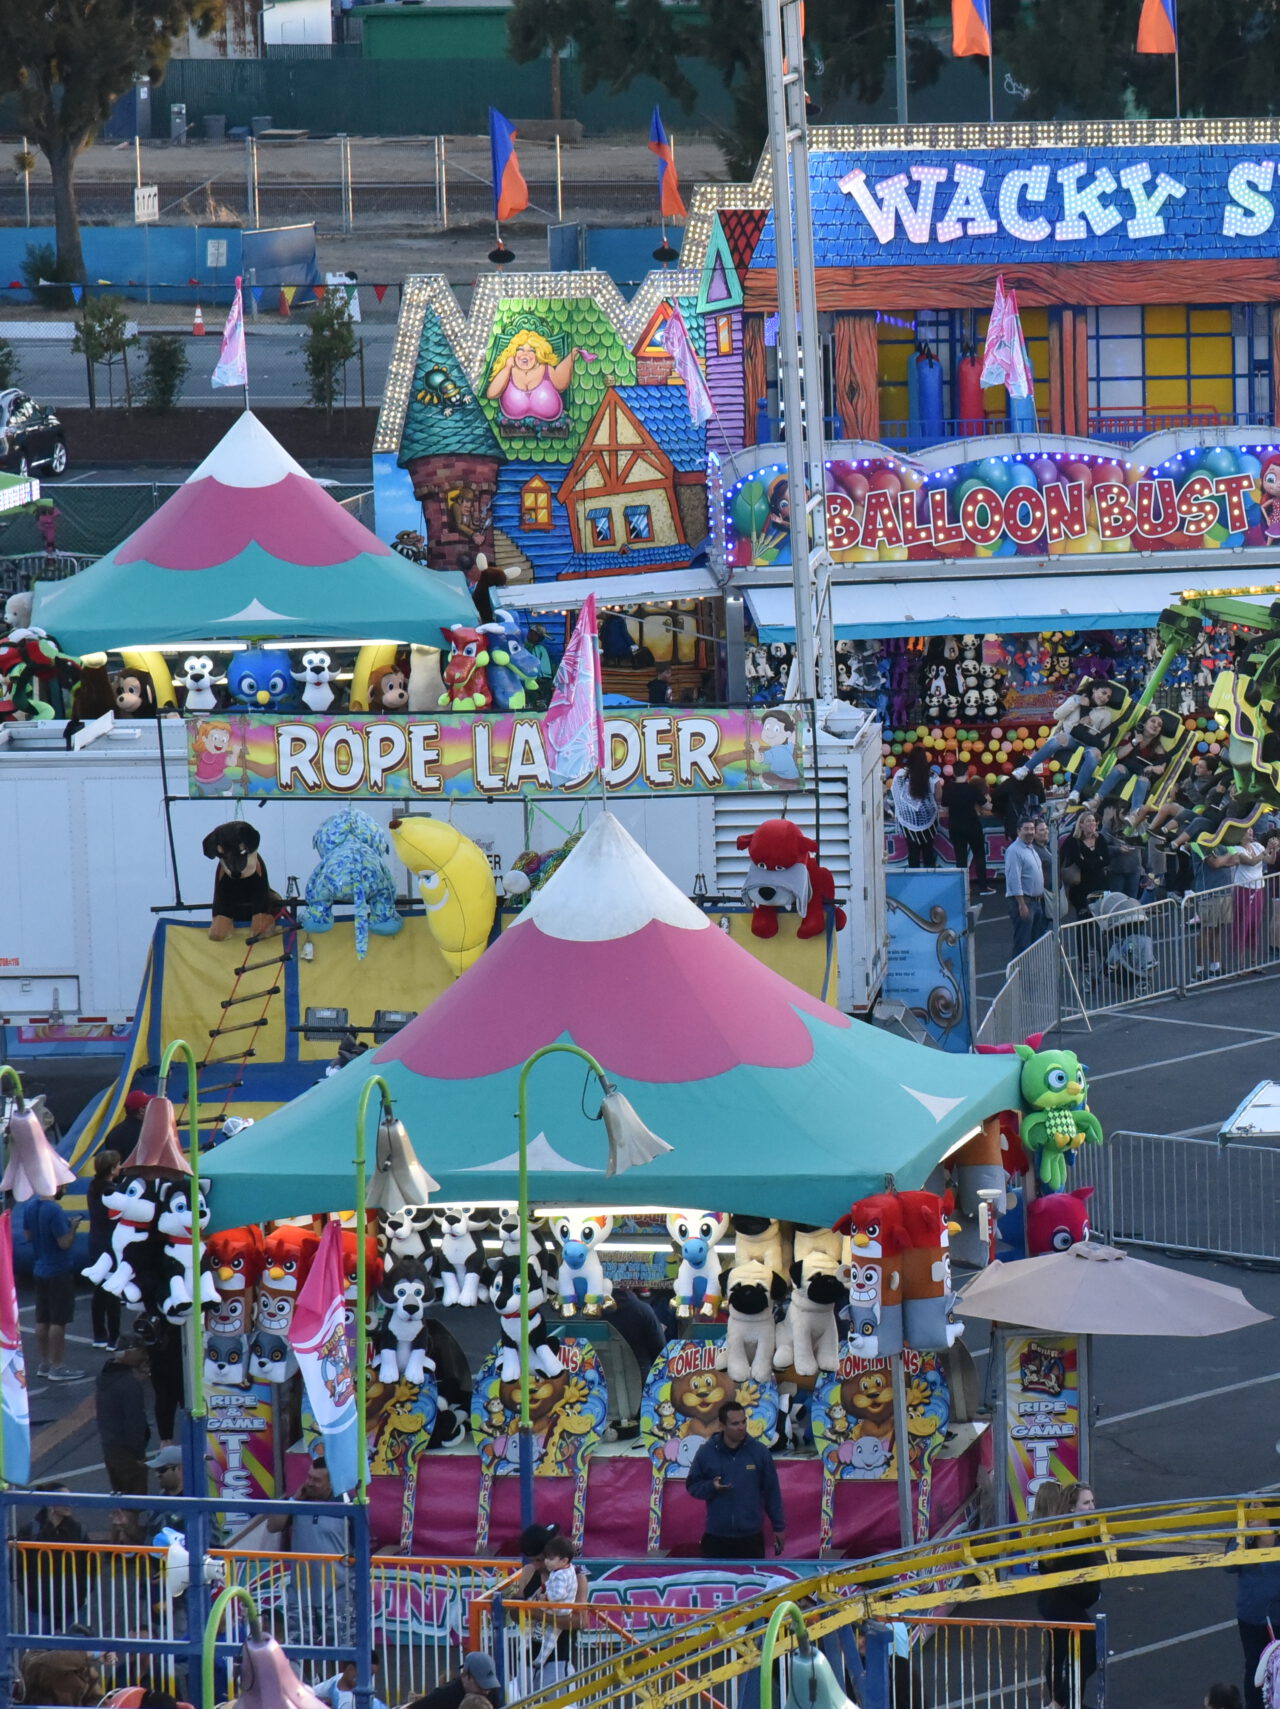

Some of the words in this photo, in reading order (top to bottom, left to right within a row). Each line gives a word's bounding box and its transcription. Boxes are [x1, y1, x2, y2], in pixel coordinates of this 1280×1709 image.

[837, 161, 1187, 244] WACKY
[826, 481, 1087, 551] BALLOON
[1095, 473, 1255, 540] BUST
[276, 722, 444, 793] ROPE
[473, 716, 724, 794] LADER
[675, 1347, 701, 1377] ONE
[702, 1346, 717, 1370] IN
[210, 1395, 257, 1407] RIDE
[226, 1406, 242, 1417] &
[1018, 1402, 1067, 1415] RIDE
[207, 1418, 266, 1431] GAME
[1011, 1424, 1076, 1438] GAME
[1034, 1414, 1051, 1424] &
[406, 1474, 415, 1503] ONE
[482, 1474, 490, 1503] ONE
[577, 1475, 585, 1504] ONE
[653, 1477, 661, 1506] ONE
[825, 1479, 833, 1508] ONE
[921, 1479, 929, 1508] ONE
